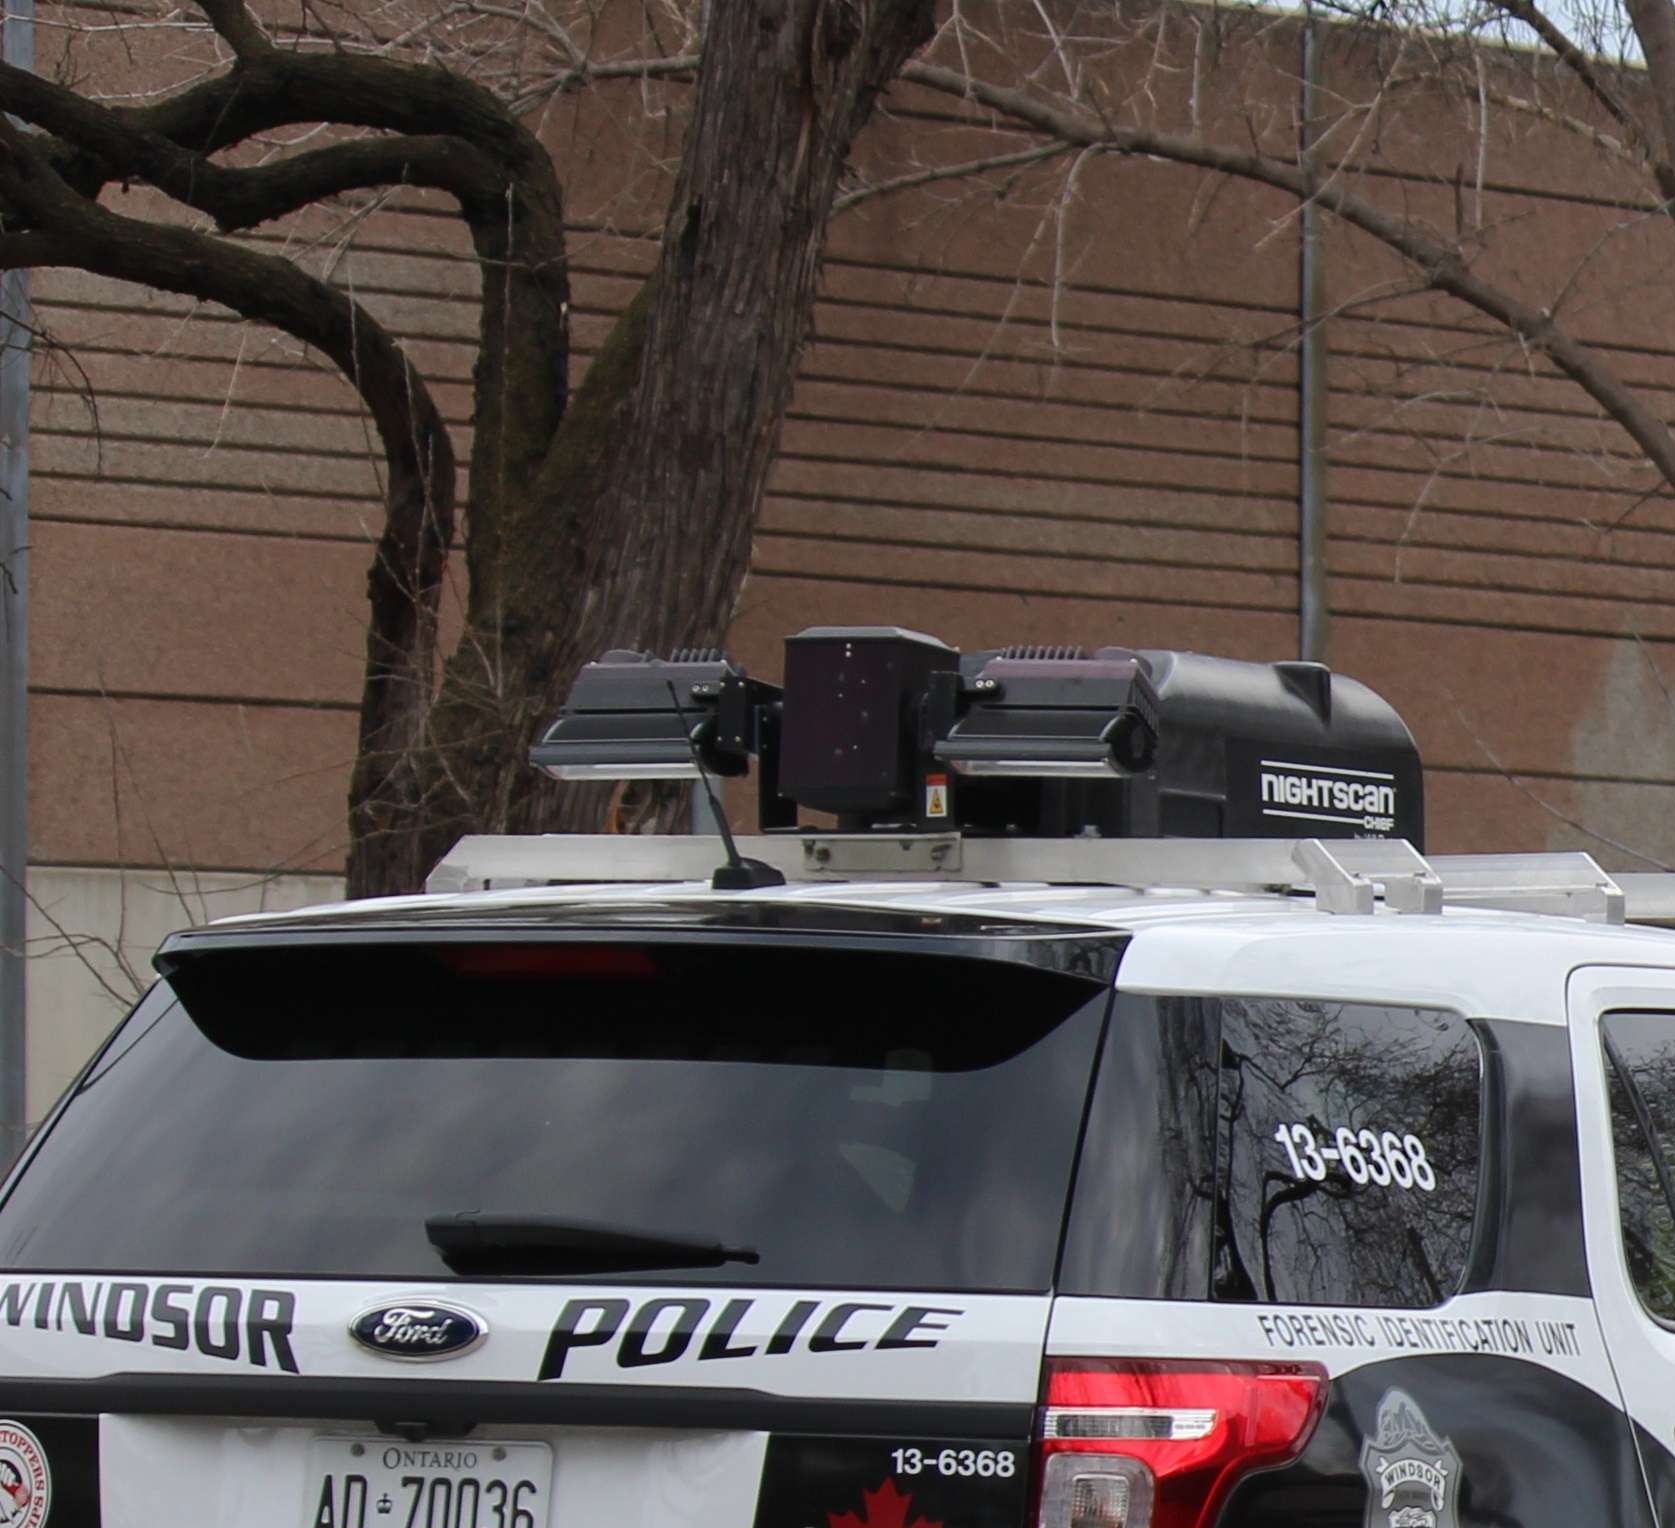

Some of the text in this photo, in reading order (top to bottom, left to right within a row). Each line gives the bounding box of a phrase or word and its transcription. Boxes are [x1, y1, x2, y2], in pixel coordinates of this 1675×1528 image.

[1364, 816, 1394, 831] CHIEF
[1275, 1123, 1436, 1191] 13-6368
[374, 1308, 453, 1343] Ford
[537, 1298, 965, 1381] POLICE
[1258, 1315, 1581, 1356] FORENSIC IDENTIFICATION UNIT
[0, 1430, 45, 1492] TOPPERS
[383, 1448, 477, 1470] ONTARIO
[891, 1448, 1015, 1478] 13-6368
[1385, 1463, 1440, 1488] WINDSOR
